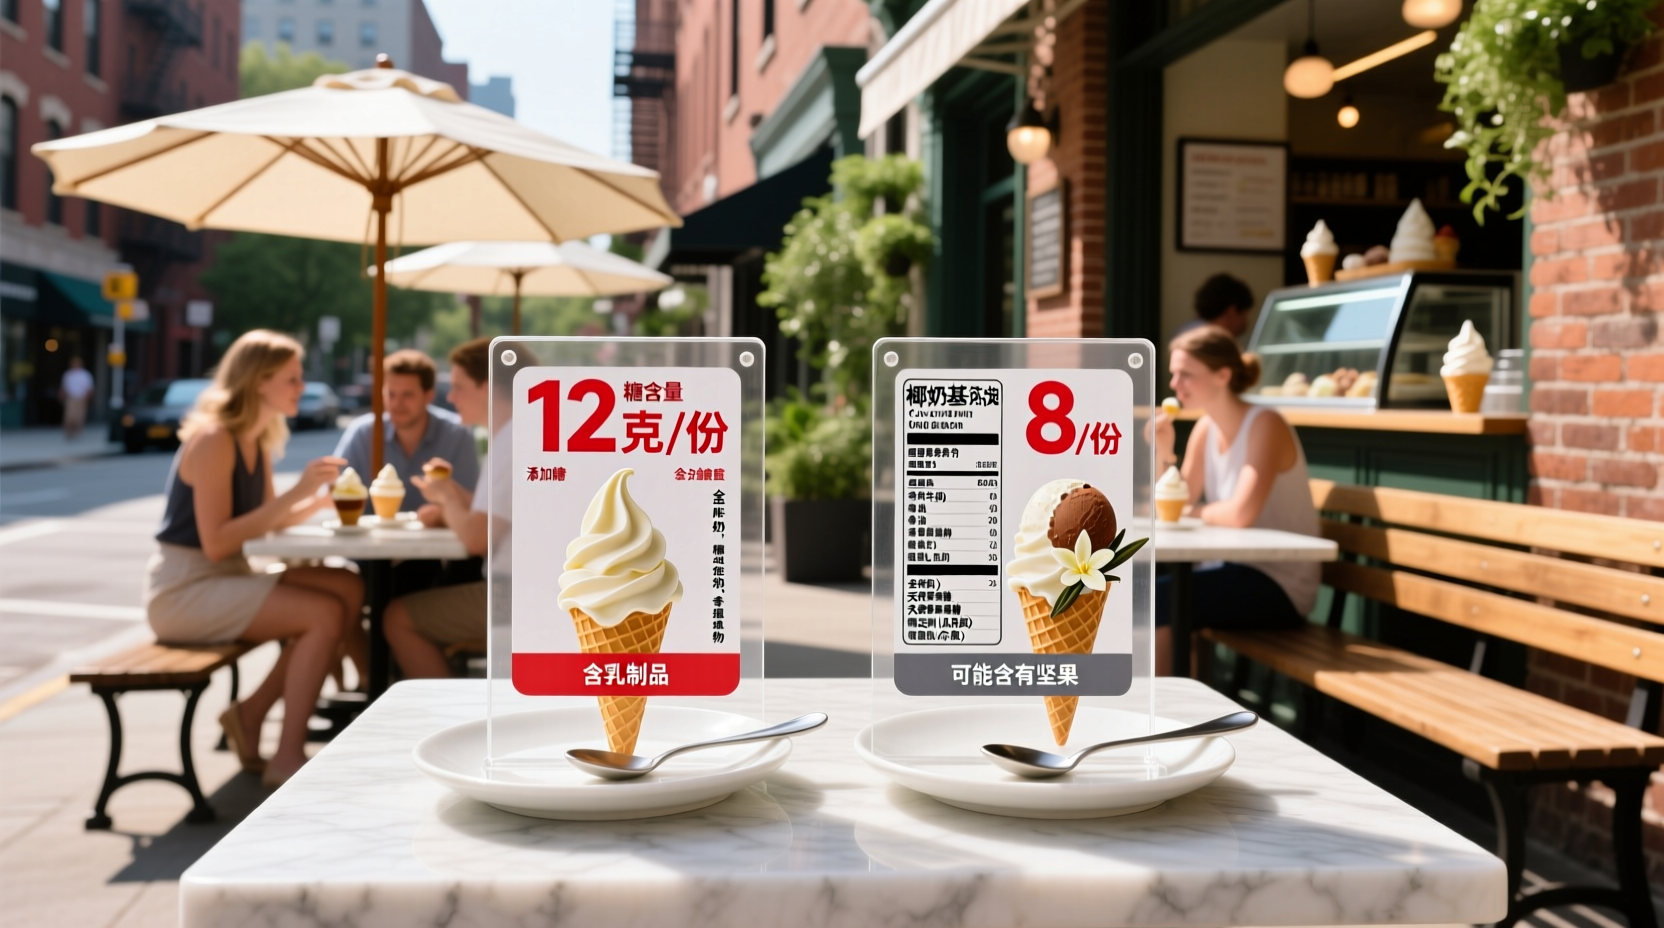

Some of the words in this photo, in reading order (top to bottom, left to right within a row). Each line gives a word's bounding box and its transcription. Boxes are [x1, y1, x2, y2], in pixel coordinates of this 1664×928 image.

[623, 381, 684, 402] 糖含量
[528, 378, 616, 453] 12
[583, 662, 670, 686] 含乳制品
[951, 662, 1079, 687] 可能含有坚果
